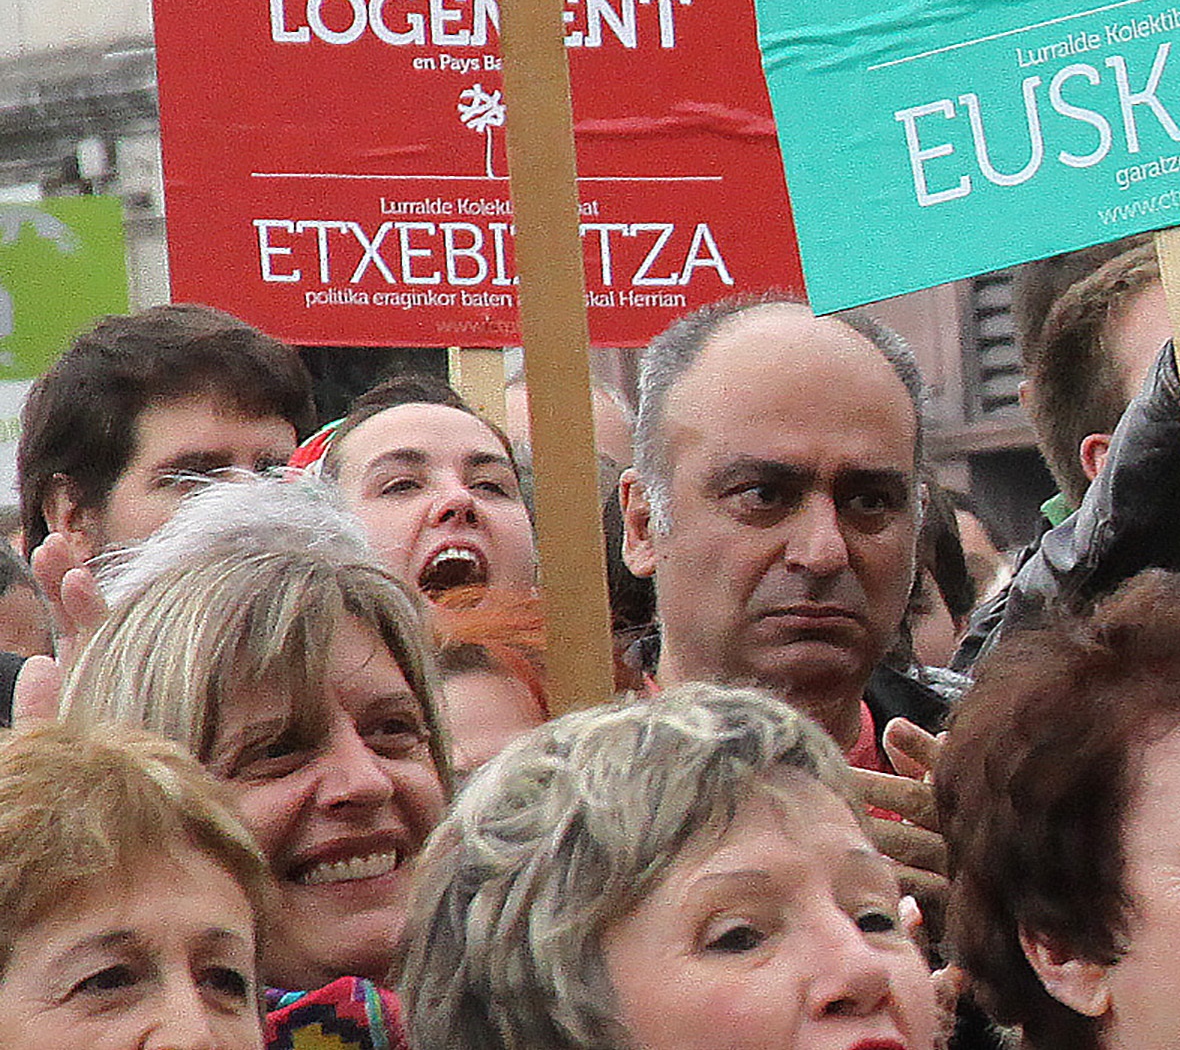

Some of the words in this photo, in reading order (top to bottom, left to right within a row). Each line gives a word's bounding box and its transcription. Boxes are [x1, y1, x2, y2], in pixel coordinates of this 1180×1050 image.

[1015, 31, 1102, 68] Lurralde
[412, 57, 436, 70] en
[439, 54, 481, 75] Pays
[380, 197, 453, 215] Lurralde
[578, 200, 599, 216] at
[252, 219, 734, 286] ETXEBITZA
[305, 287, 370, 309] politika
[372, 289, 457, 311] eraginkor
[461, 289, 513, 308] baten
[618, 289, 686, 308] Herrian
